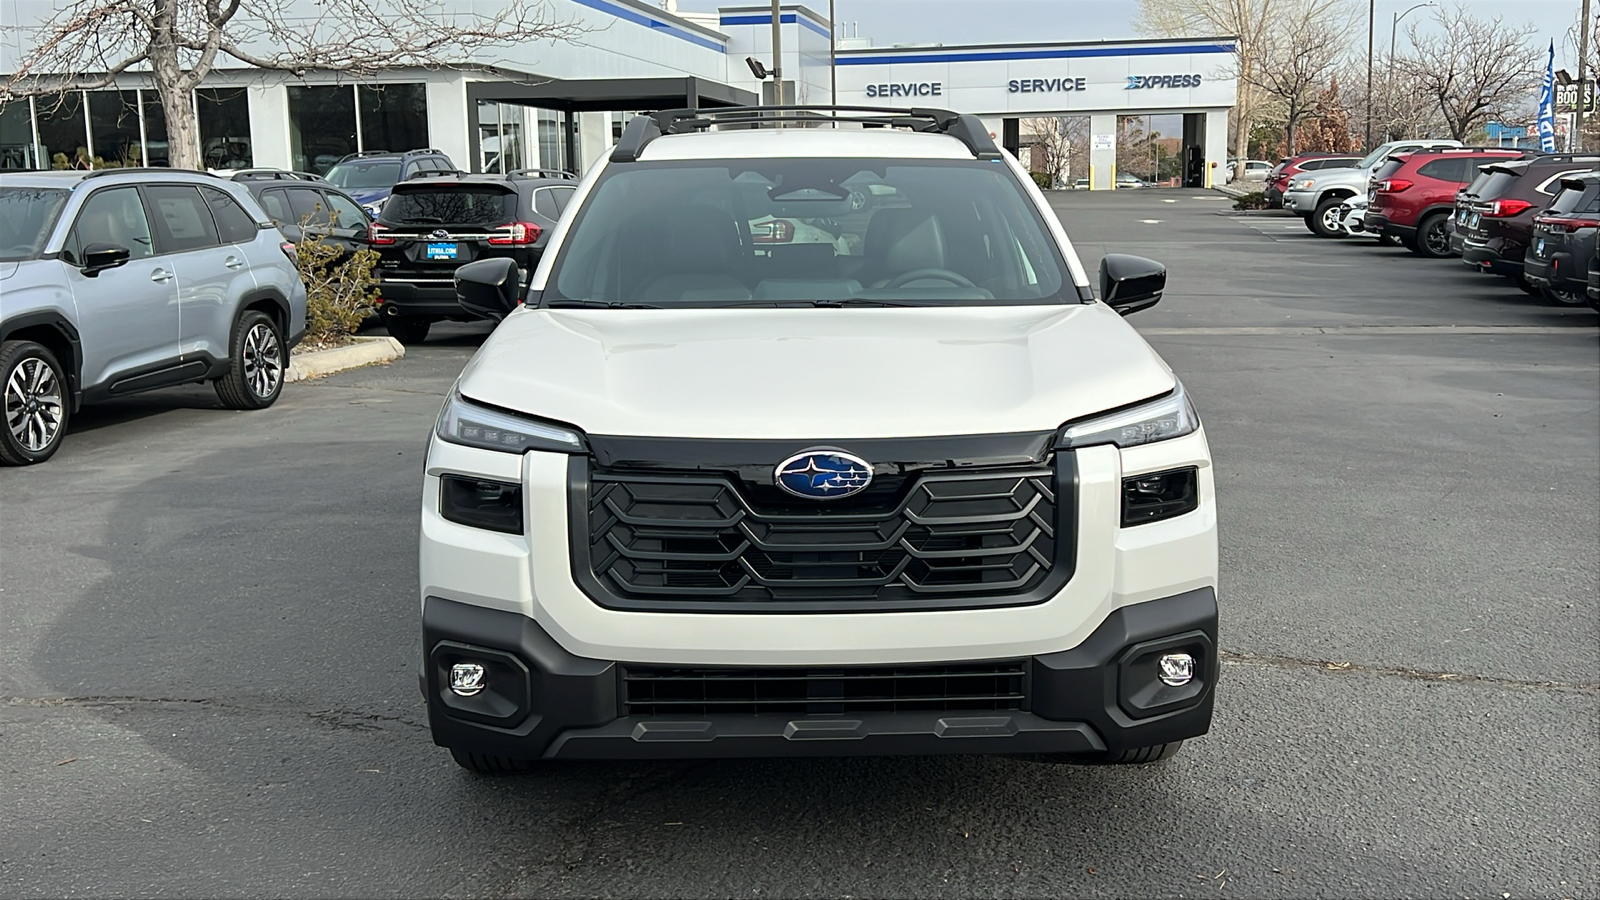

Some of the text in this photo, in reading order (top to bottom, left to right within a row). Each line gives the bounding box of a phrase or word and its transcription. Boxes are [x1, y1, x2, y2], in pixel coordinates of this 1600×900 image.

[866, 82, 942, 98] SERVICE
[1008, 77, 1086, 94] SERVICE
[1124, 74, 1202, 90] EXPRESS
[1556, 91, 1591, 104] BOOS
